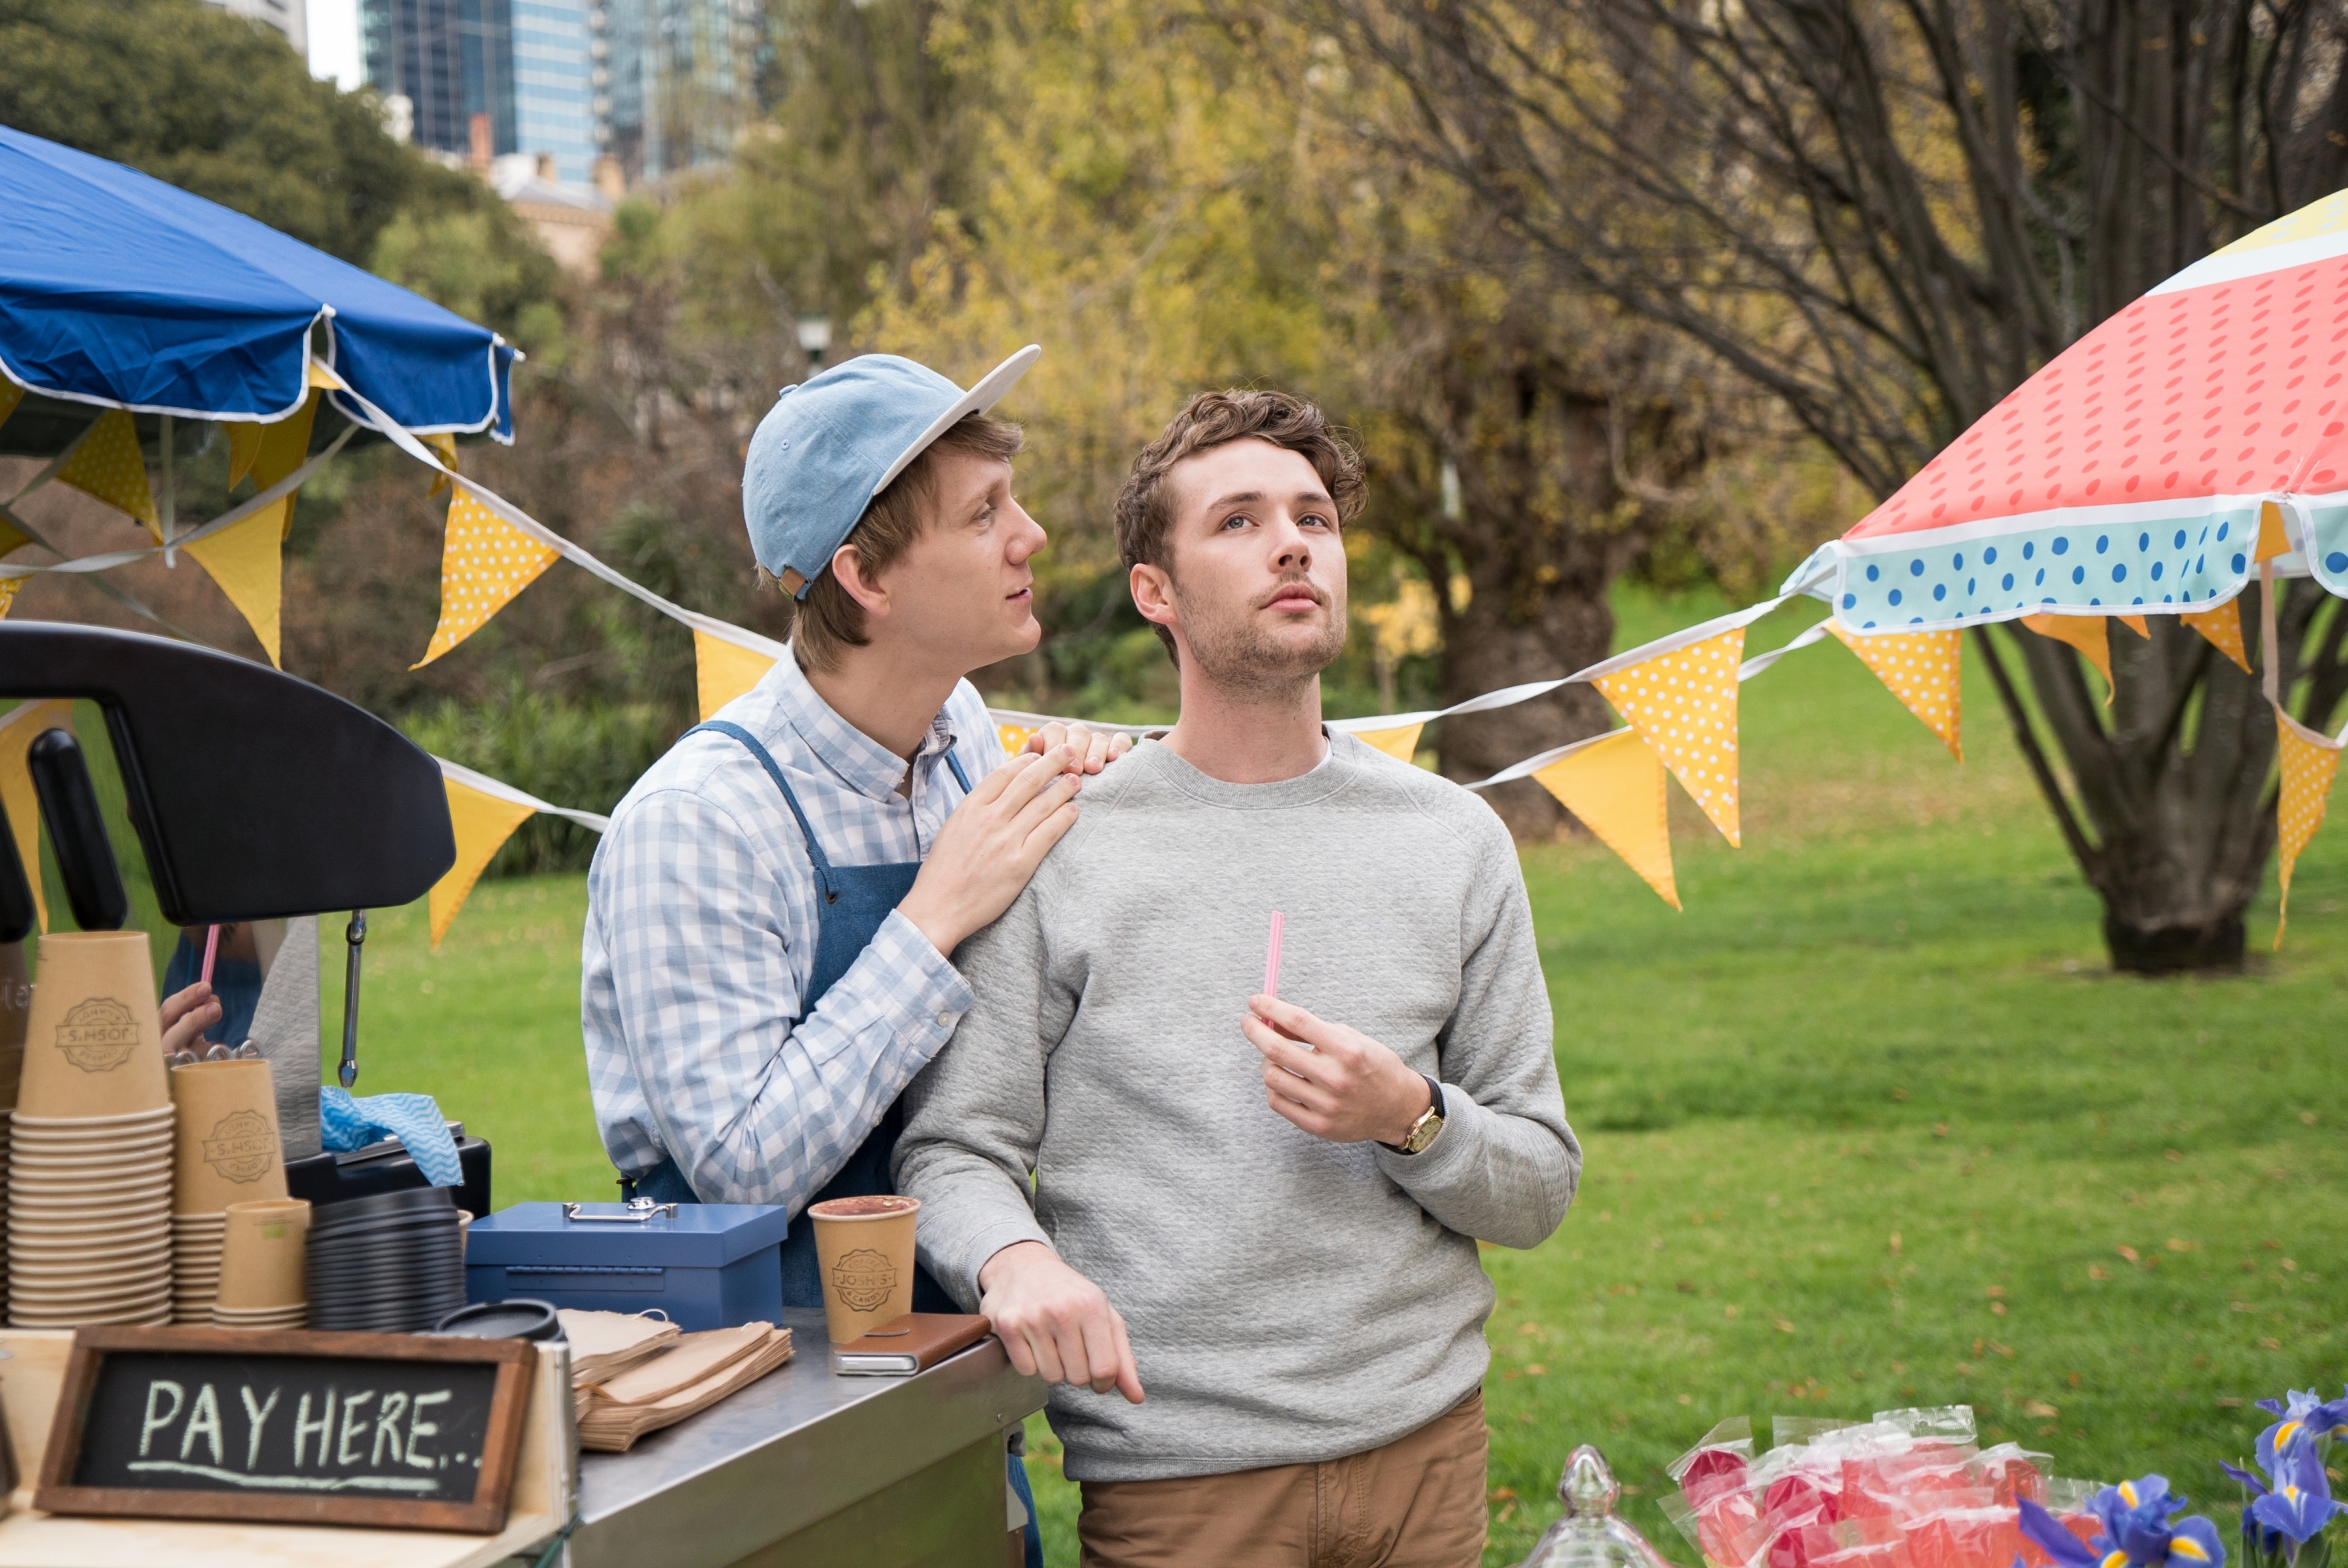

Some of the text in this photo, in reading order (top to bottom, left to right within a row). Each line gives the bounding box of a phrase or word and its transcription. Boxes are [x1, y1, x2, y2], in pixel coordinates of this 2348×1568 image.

[68, 1028, 129, 1041] JOSH'S
[217, 1138, 268, 1156] JOSH'S
[228, 1158, 262, 1172] COFFEE
[848, 1258, 880, 1268] COFFEE
[853, 1293, 881, 1303] CANDY
[139, 1379, 283, 1471] PAY
